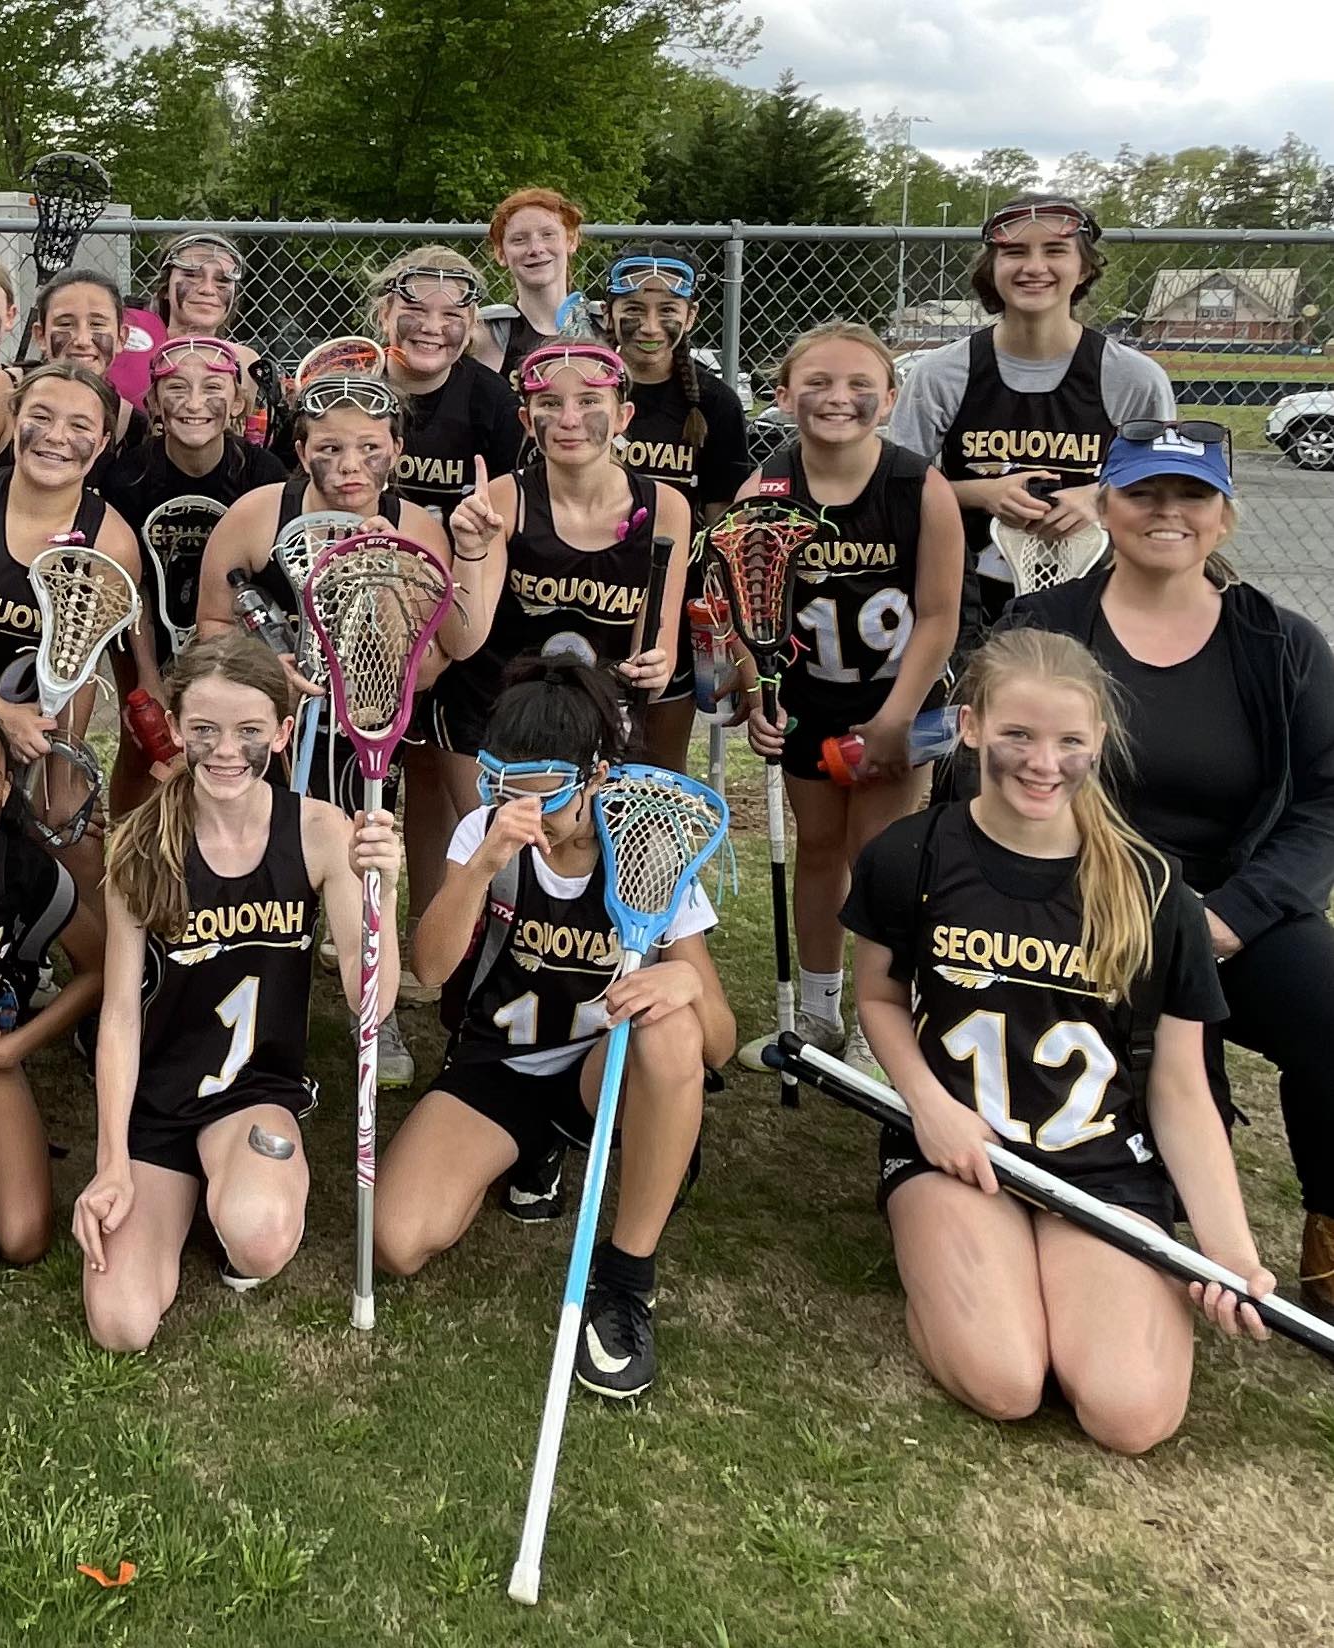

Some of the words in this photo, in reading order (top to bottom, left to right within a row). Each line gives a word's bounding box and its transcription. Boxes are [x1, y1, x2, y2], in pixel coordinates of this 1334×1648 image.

[610, 441, 693, 472] UOYAH
[962, 430, 1101, 461] SEQUOYAH
[394, 455, 464, 484] OYAH
[760, 482, 786, 492] STX
[797, 541, 896, 569] QUOYA
[510, 568, 647, 615] SEQUOYAH
[797, 588, 915, 683] 19
[182, 901, 305, 944] EQUOYAH
[490, 902, 515, 921] STX
[514, 919, 618, 961] EQUOYA
[932, 925, 1090, 981] SEQUOYA
[198, 975, 261, 1099] 1
[940, 1009, 1118, 1152] 12
